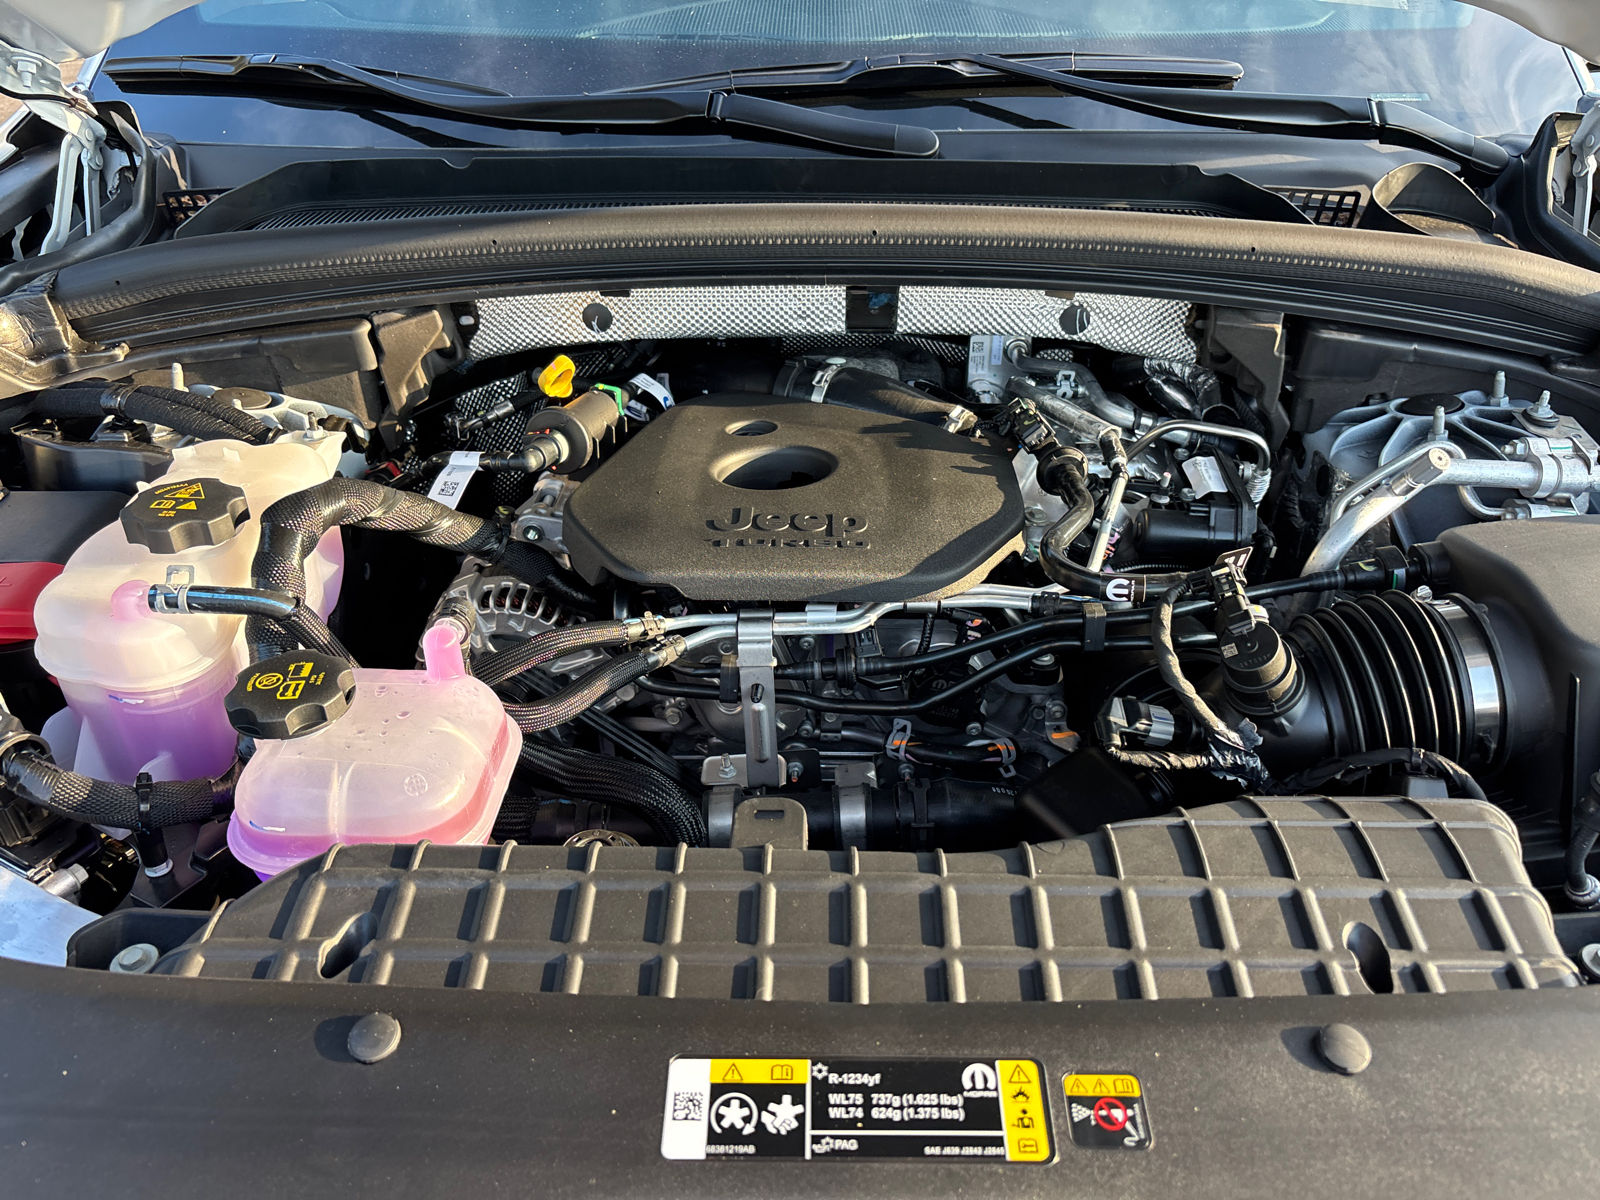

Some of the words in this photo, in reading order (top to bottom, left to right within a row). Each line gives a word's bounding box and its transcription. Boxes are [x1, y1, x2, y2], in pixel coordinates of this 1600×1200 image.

[705, 506, 869, 538] Jeep
[828, 1073, 881, 1087] R-1234yf
[828, 1093, 864, 1106] WL75
[870, 1093, 901, 1108] 737g
[902, 1093, 939, 1108] (1.625
[939, 1093, 964, 1108] lbs)
[828, 1107, 864, 1119] WL74
[870, 1107, 902, 1121] 624g
[902, 1107, 939, 1121] (1.375
[940, 1107, 965, 1122] lbs)
[835, 1139, 859, 1150] PAG
